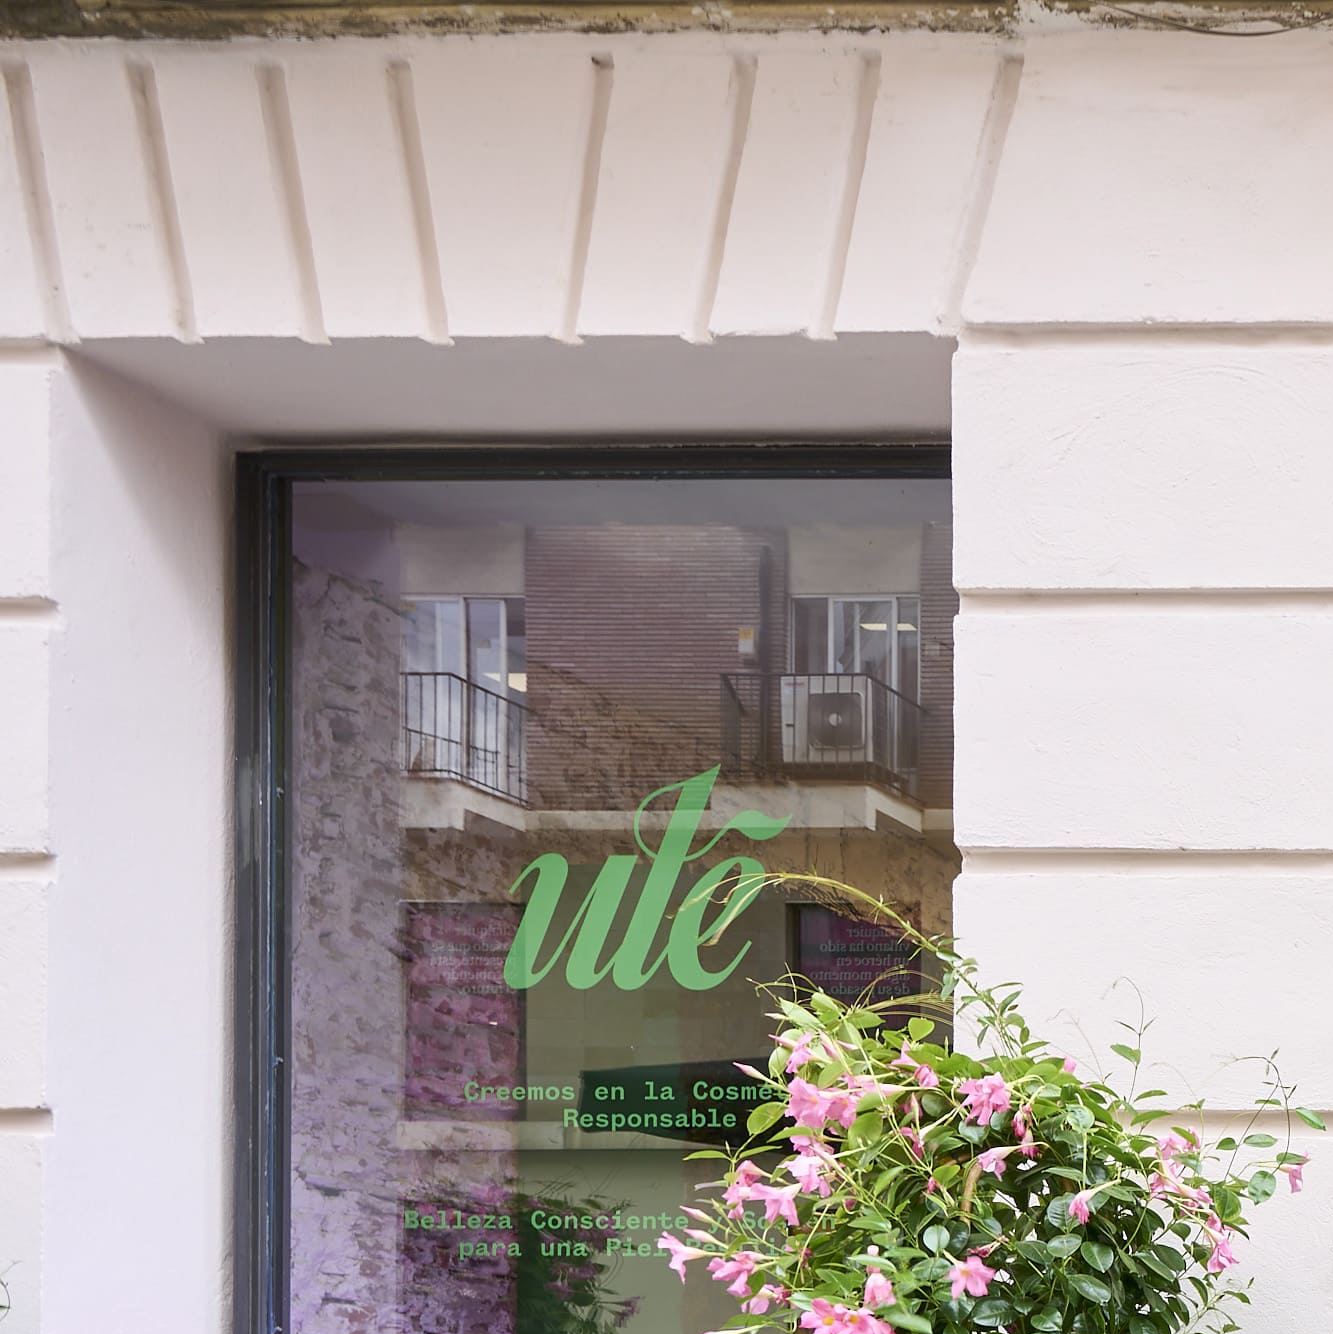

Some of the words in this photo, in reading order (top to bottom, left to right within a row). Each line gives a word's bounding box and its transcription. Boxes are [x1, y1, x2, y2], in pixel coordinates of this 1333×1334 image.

[463, 1080, 575, 1101] Creemos
[594, 1086, 625, 1101] en
[644, 1081, 675, 1101] la
[563, 1108, 737, 1132] Responsable
[404, 1210, 513, 1230] Belleza
[531, 1210, 689, 1230] Consciente
[459, 1241, 522, 1261] para
[540, 1241, 587, 1257] una
[606, 1236, 667, 1257] Piel
